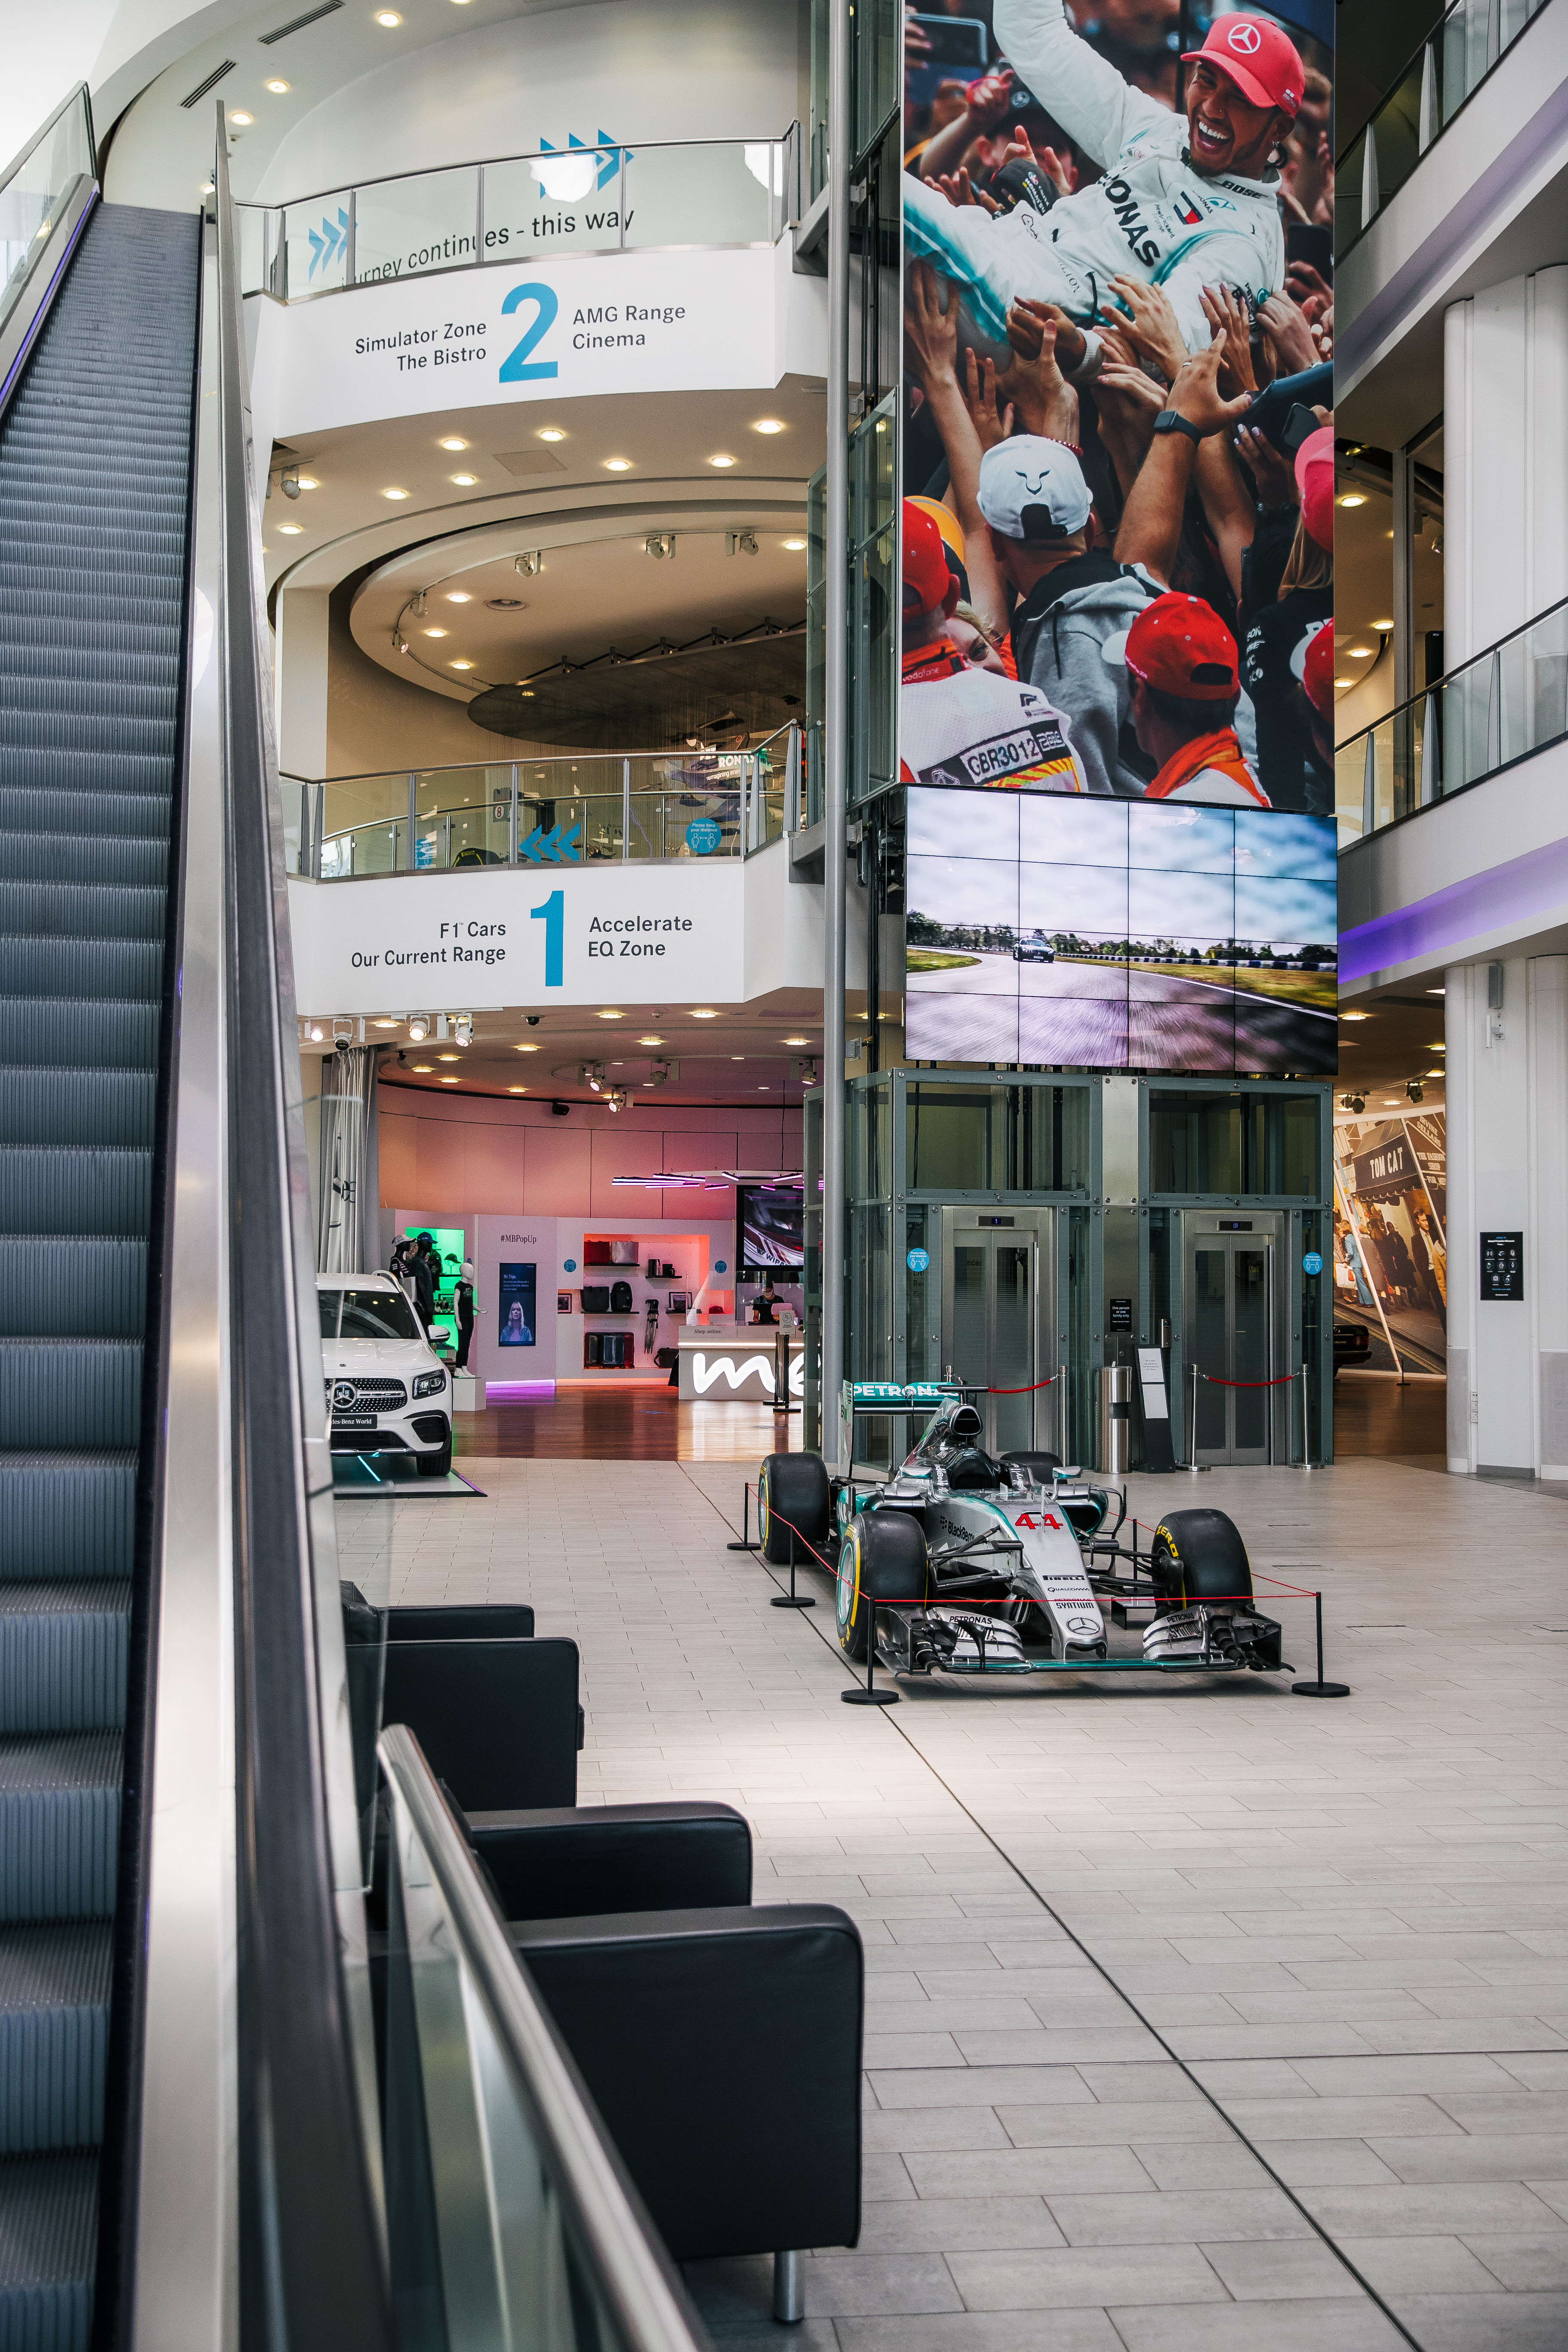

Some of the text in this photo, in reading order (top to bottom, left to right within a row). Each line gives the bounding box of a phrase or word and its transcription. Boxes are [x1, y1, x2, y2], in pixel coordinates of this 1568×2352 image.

[1221, 180, 1268, 199] BOSE
[532, 212, 576, 237] this
[573, 305, 686, 325] AMG Range
[355, 322, 487, 354] Simulator Zone
[499, 282, 559, 383] 2
[573, 332, 646, 349] Cinema
[397, 347, 487, 371] The Bistro
[903, 668, 940, 682] vodafone
[467, 921, 506, 937] Cars
[589, 916, 693, 933] Accelerate
[530, 890, 564, 987] 1
[351, 946, 506, 968] Our Current Range
[588, 940, 666, 958] EQ Zone
[1369, 1147, 1403, 1179] TOM CAT
[500, 1234, 537, 1245] #MBPopUp
[1014, 1513, 1064, 1530] 44
[1156, 1525, 1179, 1557] ZERO
[1166, 1612, 1195, 1623] PETRONAS
